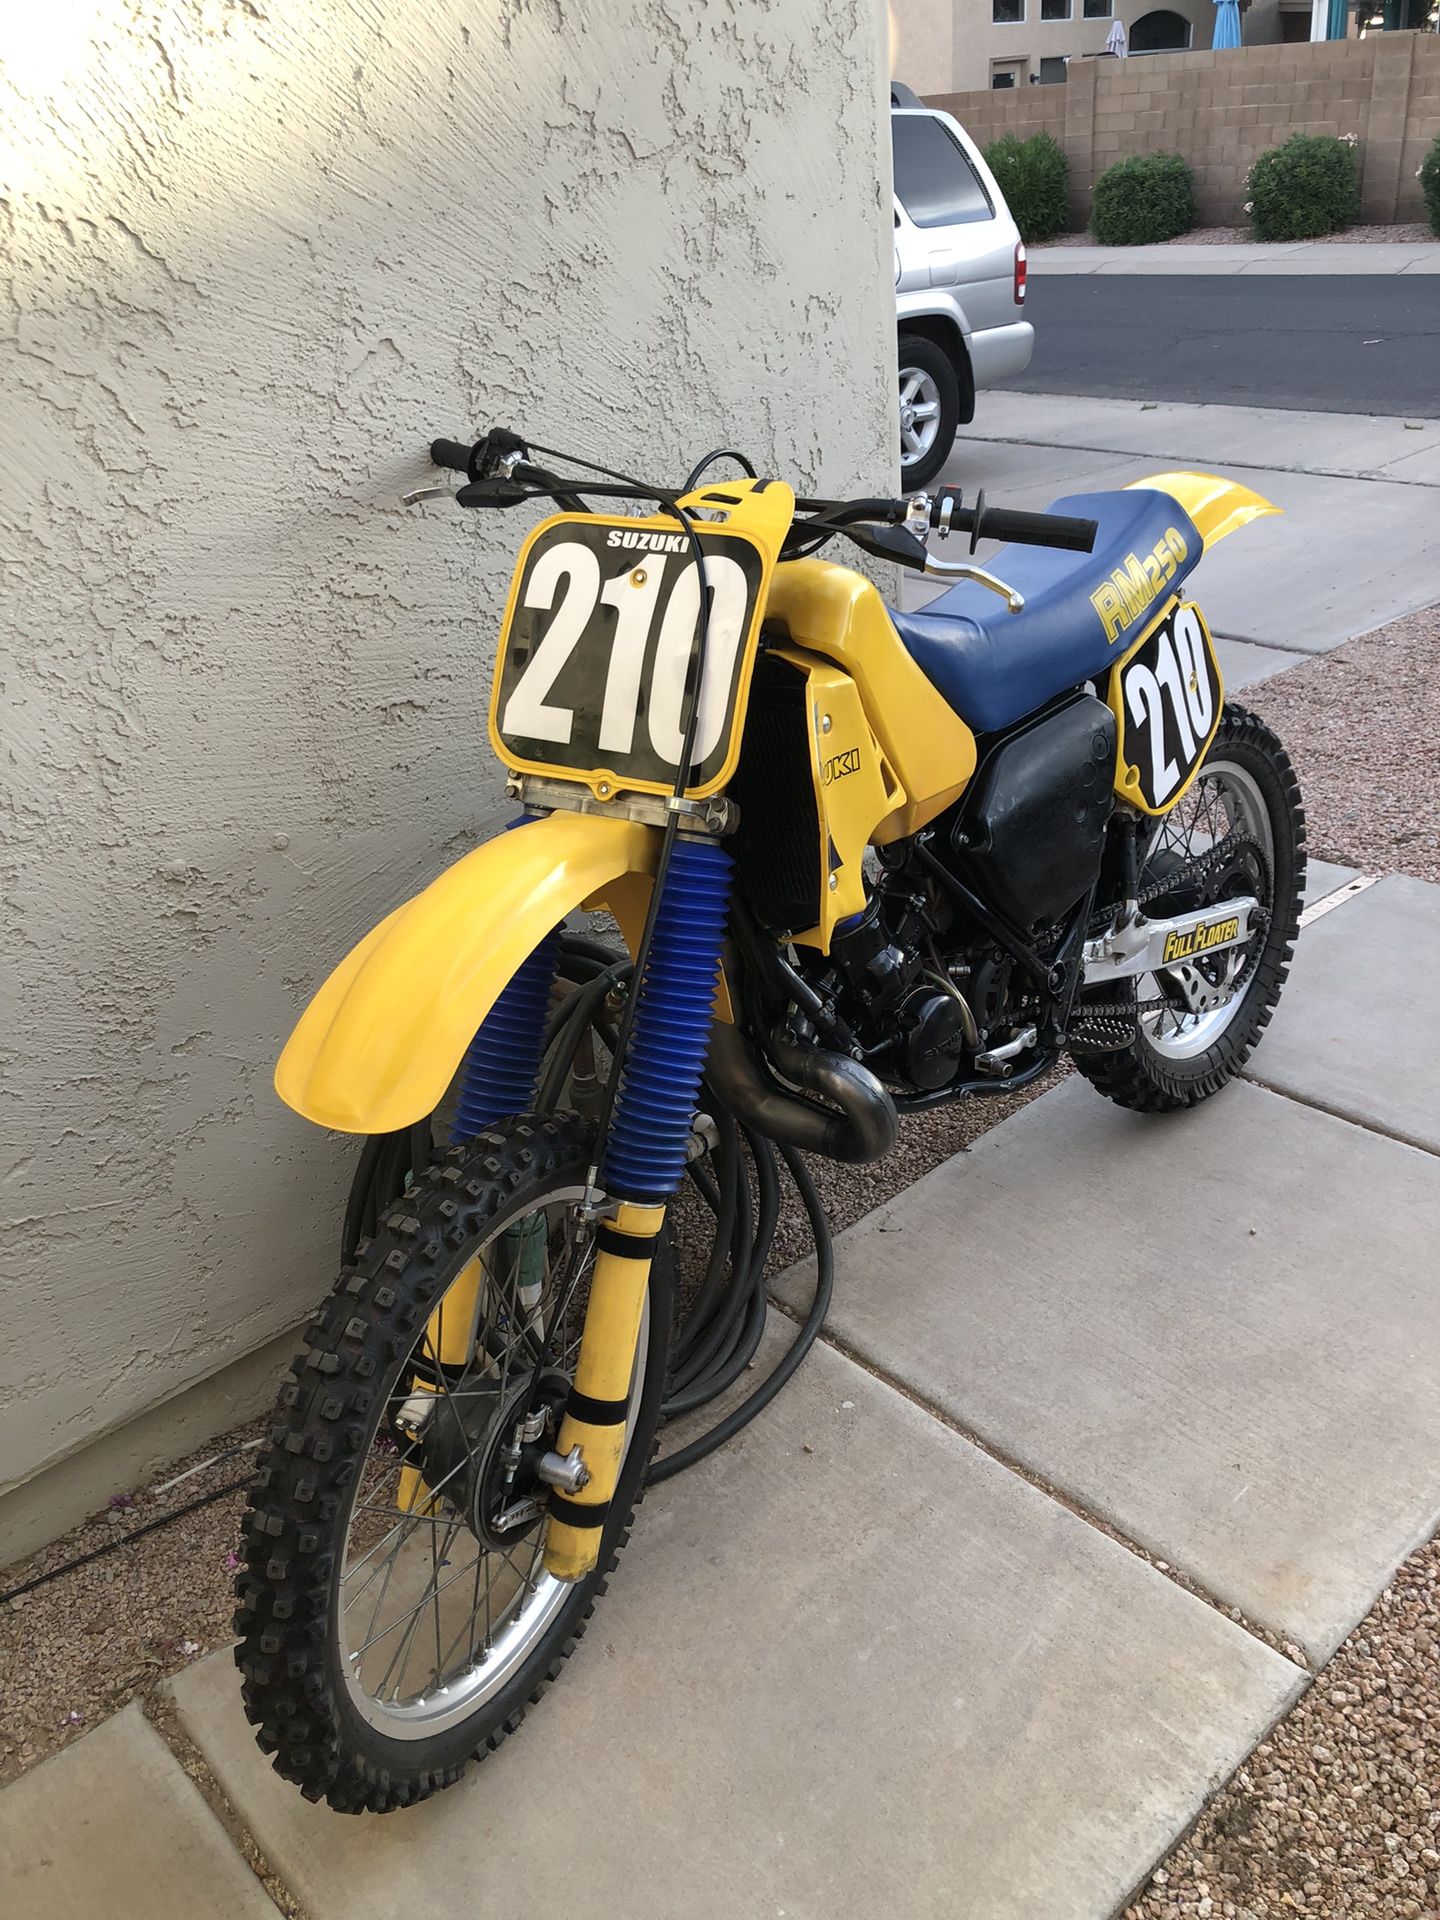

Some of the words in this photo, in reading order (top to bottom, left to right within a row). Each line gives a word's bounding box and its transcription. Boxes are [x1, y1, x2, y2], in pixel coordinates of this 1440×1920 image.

[607, 530, 691, 554] SUZUKI
[1089, 526, 1189, 645] RM250
[502, 541, 748, 767] 210
[1124, 606, 1213, 808] 210
[1163, 931, 1194, 964] FULL
[1193, 917, 1239, 951] FLOATER
